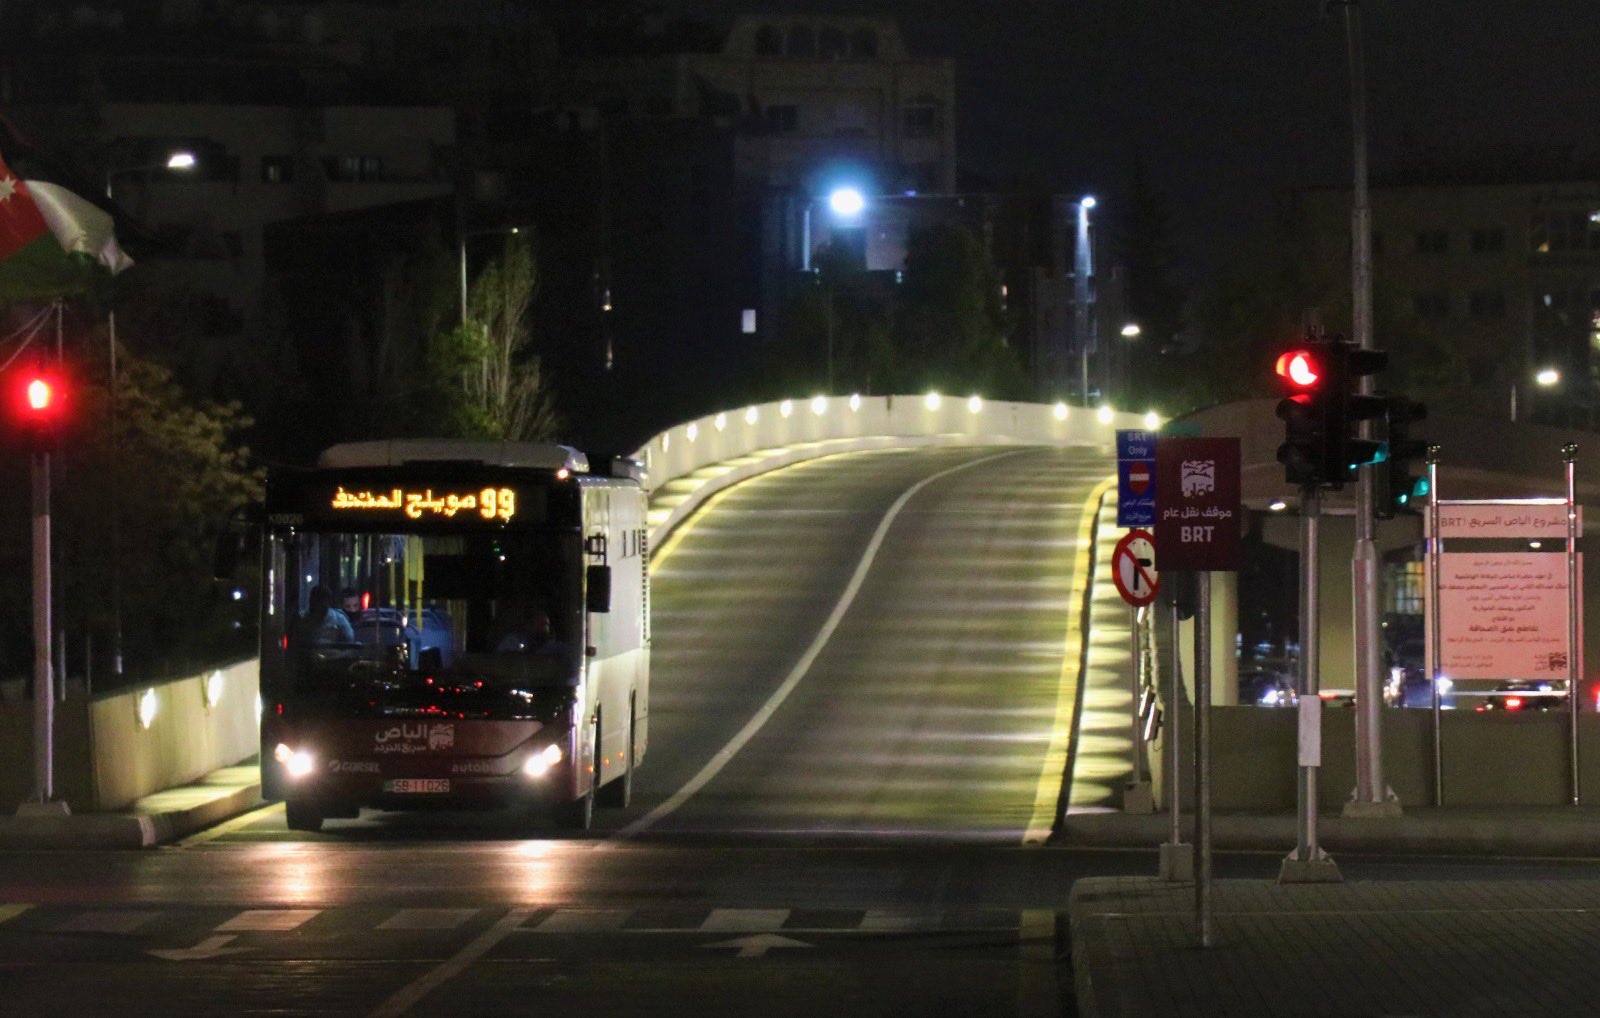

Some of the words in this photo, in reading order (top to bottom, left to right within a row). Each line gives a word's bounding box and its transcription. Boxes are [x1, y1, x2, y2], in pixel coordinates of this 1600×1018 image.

[480, 488, 515, 519] 99
[1163, 507, 1179, 520] عام
[1181, 507, 1200, 518] نقل
[1201, 506, 1232, 520] موقف
[1181, 526, 1215, 542] BRT
[375, 723, 428, 743] الباص
